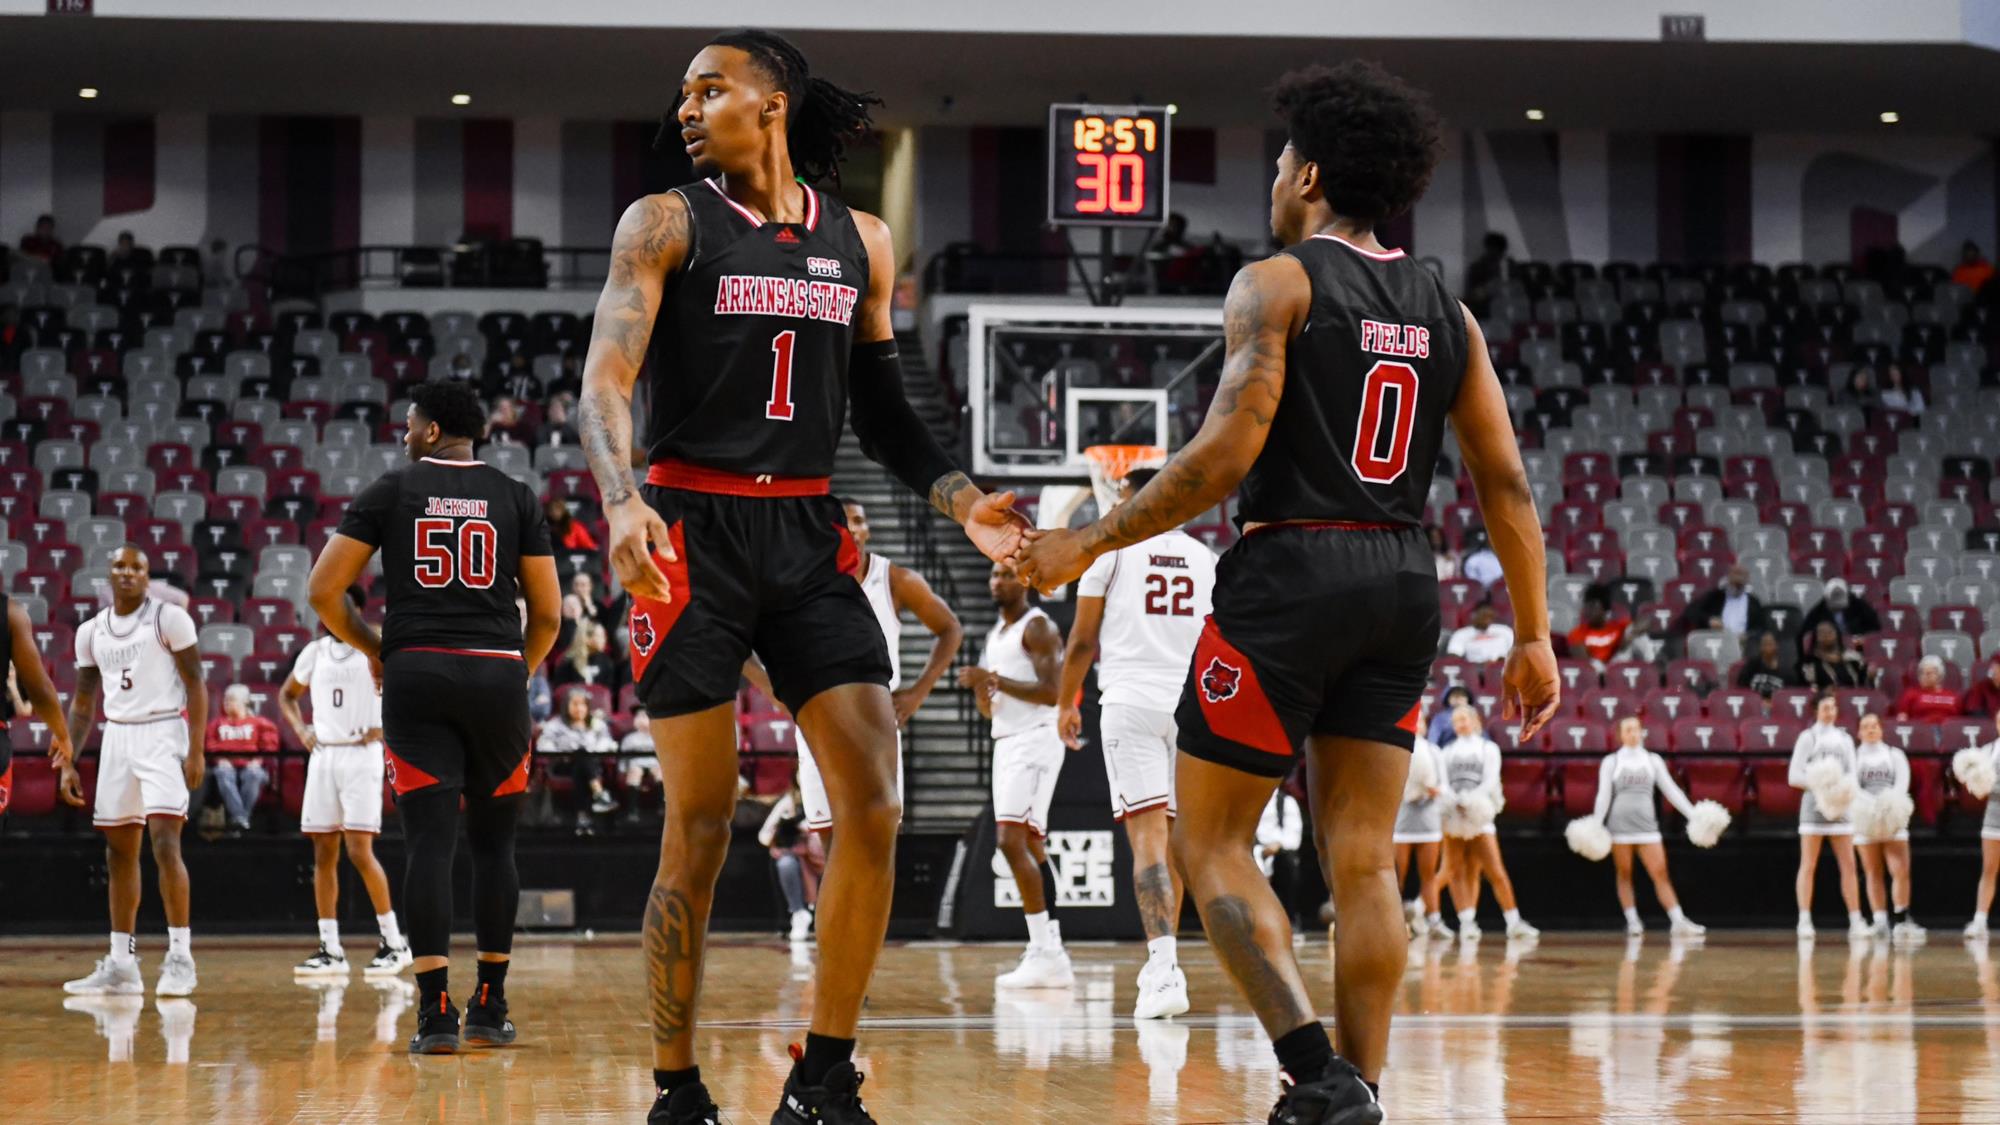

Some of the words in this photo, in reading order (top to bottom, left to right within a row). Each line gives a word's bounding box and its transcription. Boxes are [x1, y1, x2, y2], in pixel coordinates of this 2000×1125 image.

[1073, 117, 1156, 152] 12:57
[1075, 153, 1145, 213] 30
[807, 256, 842, 278] SBC
[714, 275, 808, 318] ARKANSAS
[808, 280, 858, 326] STATE
[1361, 319, 1430, 358] FIELDS
[766, 330, 796, 421] 1
[1351, 360, 1419, 485] 0
[425, 497, 488, 518] JACKSON
[415, 518, 497, 589] 50
[1145, 573, 1194, 617] 22
[120, 668, 133, 690] 5
